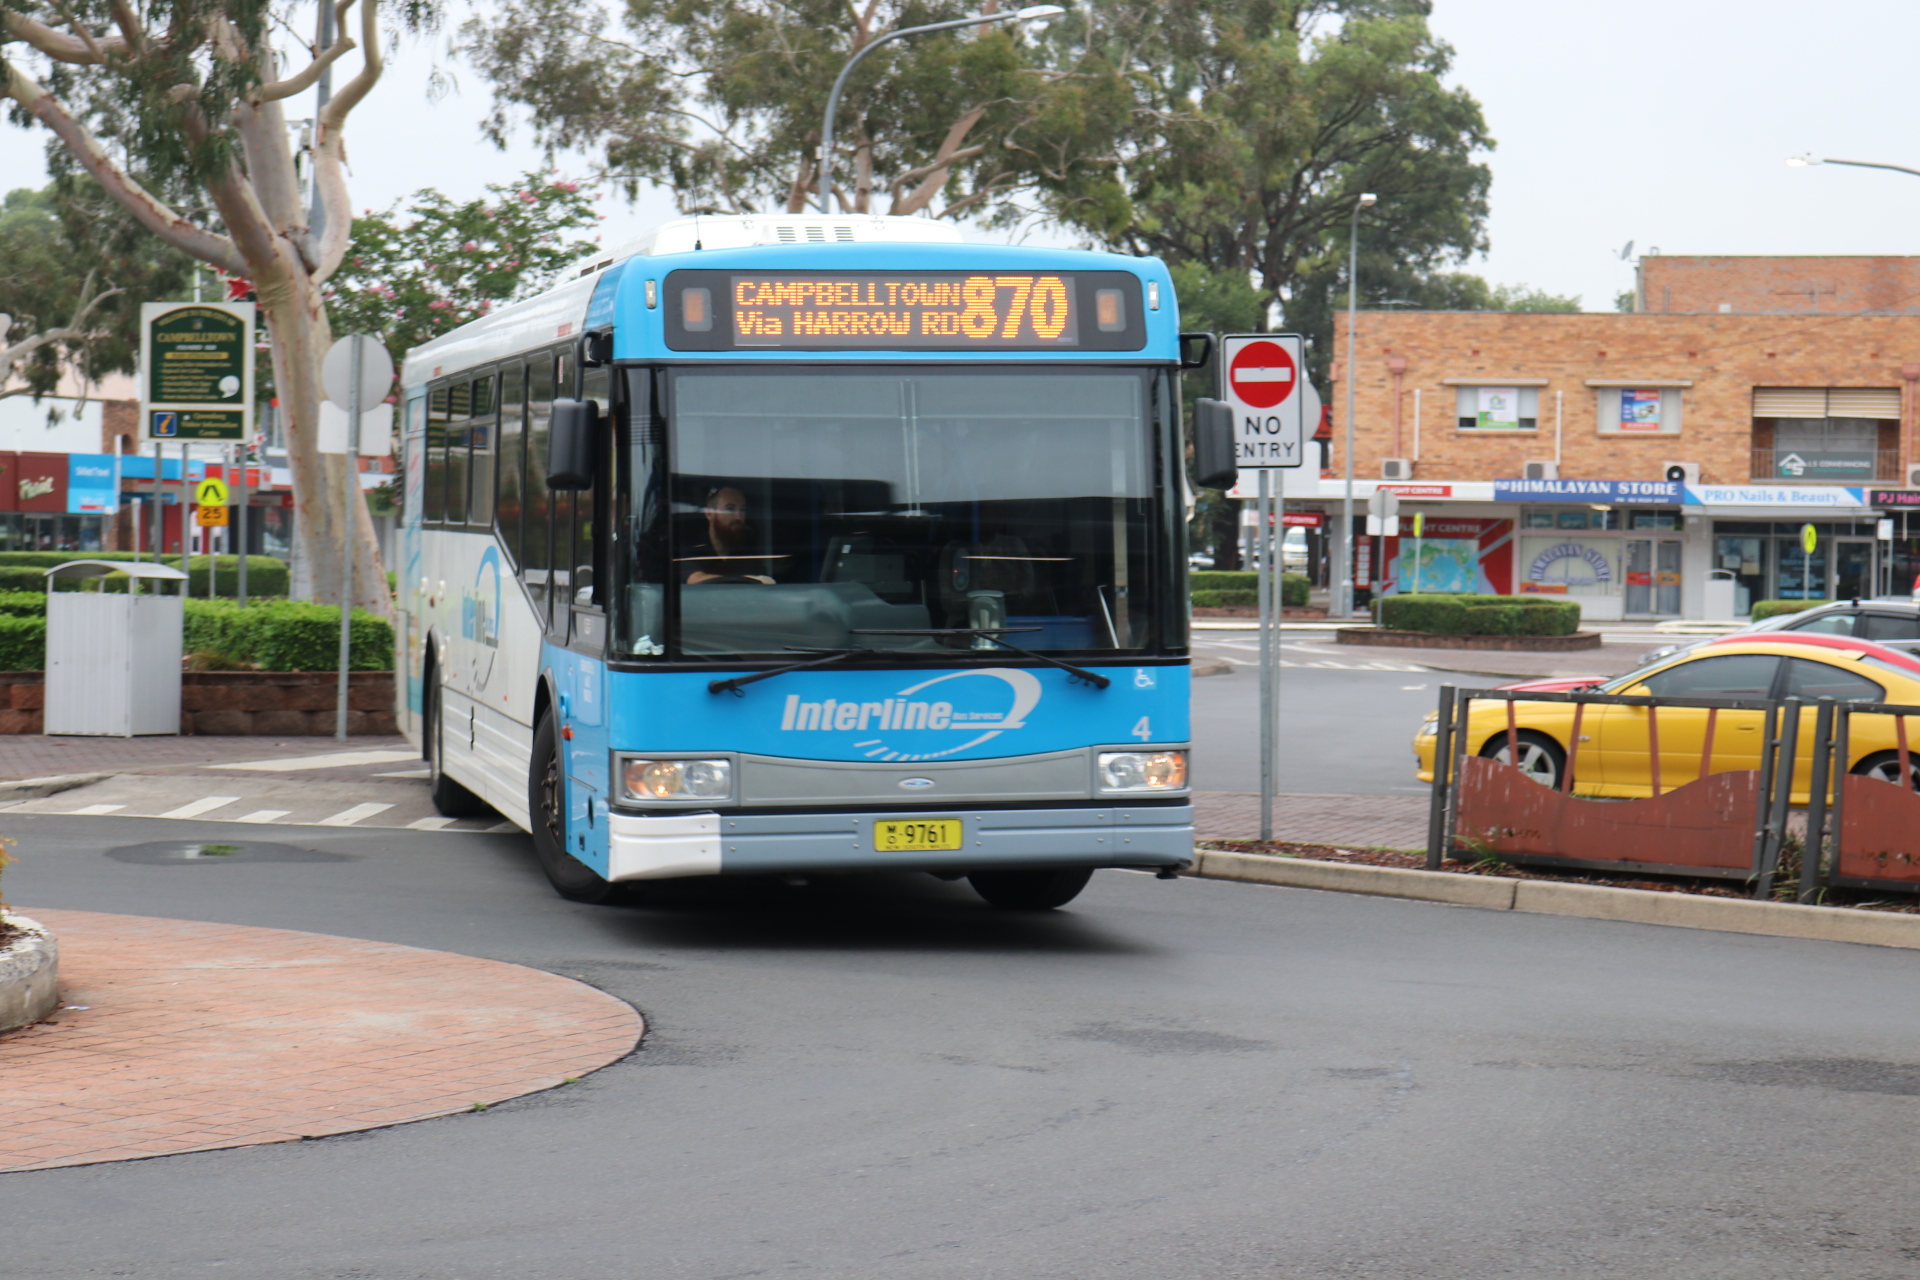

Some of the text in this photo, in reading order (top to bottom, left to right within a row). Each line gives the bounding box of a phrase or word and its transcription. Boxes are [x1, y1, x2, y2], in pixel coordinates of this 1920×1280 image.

[736, 276, 1068, 339] CAMPBELLTOWN 870
[736, 311, 959, 335] Via HARROW RD
[1246, 416, 1281, 435] NO
[1510, 481, 1611, 494] HIMALAYAN
[1618, 482, 1678, 496] STORE
[1704, 489, 1840, 505] PRO Nails & Beauty
[1877, 492, 1895, 504] PJ
[202, 508, 221, 519] 25
[1438, 523, 1481, 533] CENTRE
[780, 694, 953, 731] Interline
[952, 712, 1004, 721] Bus Services
[1131, 716, 1152, 741] 4
